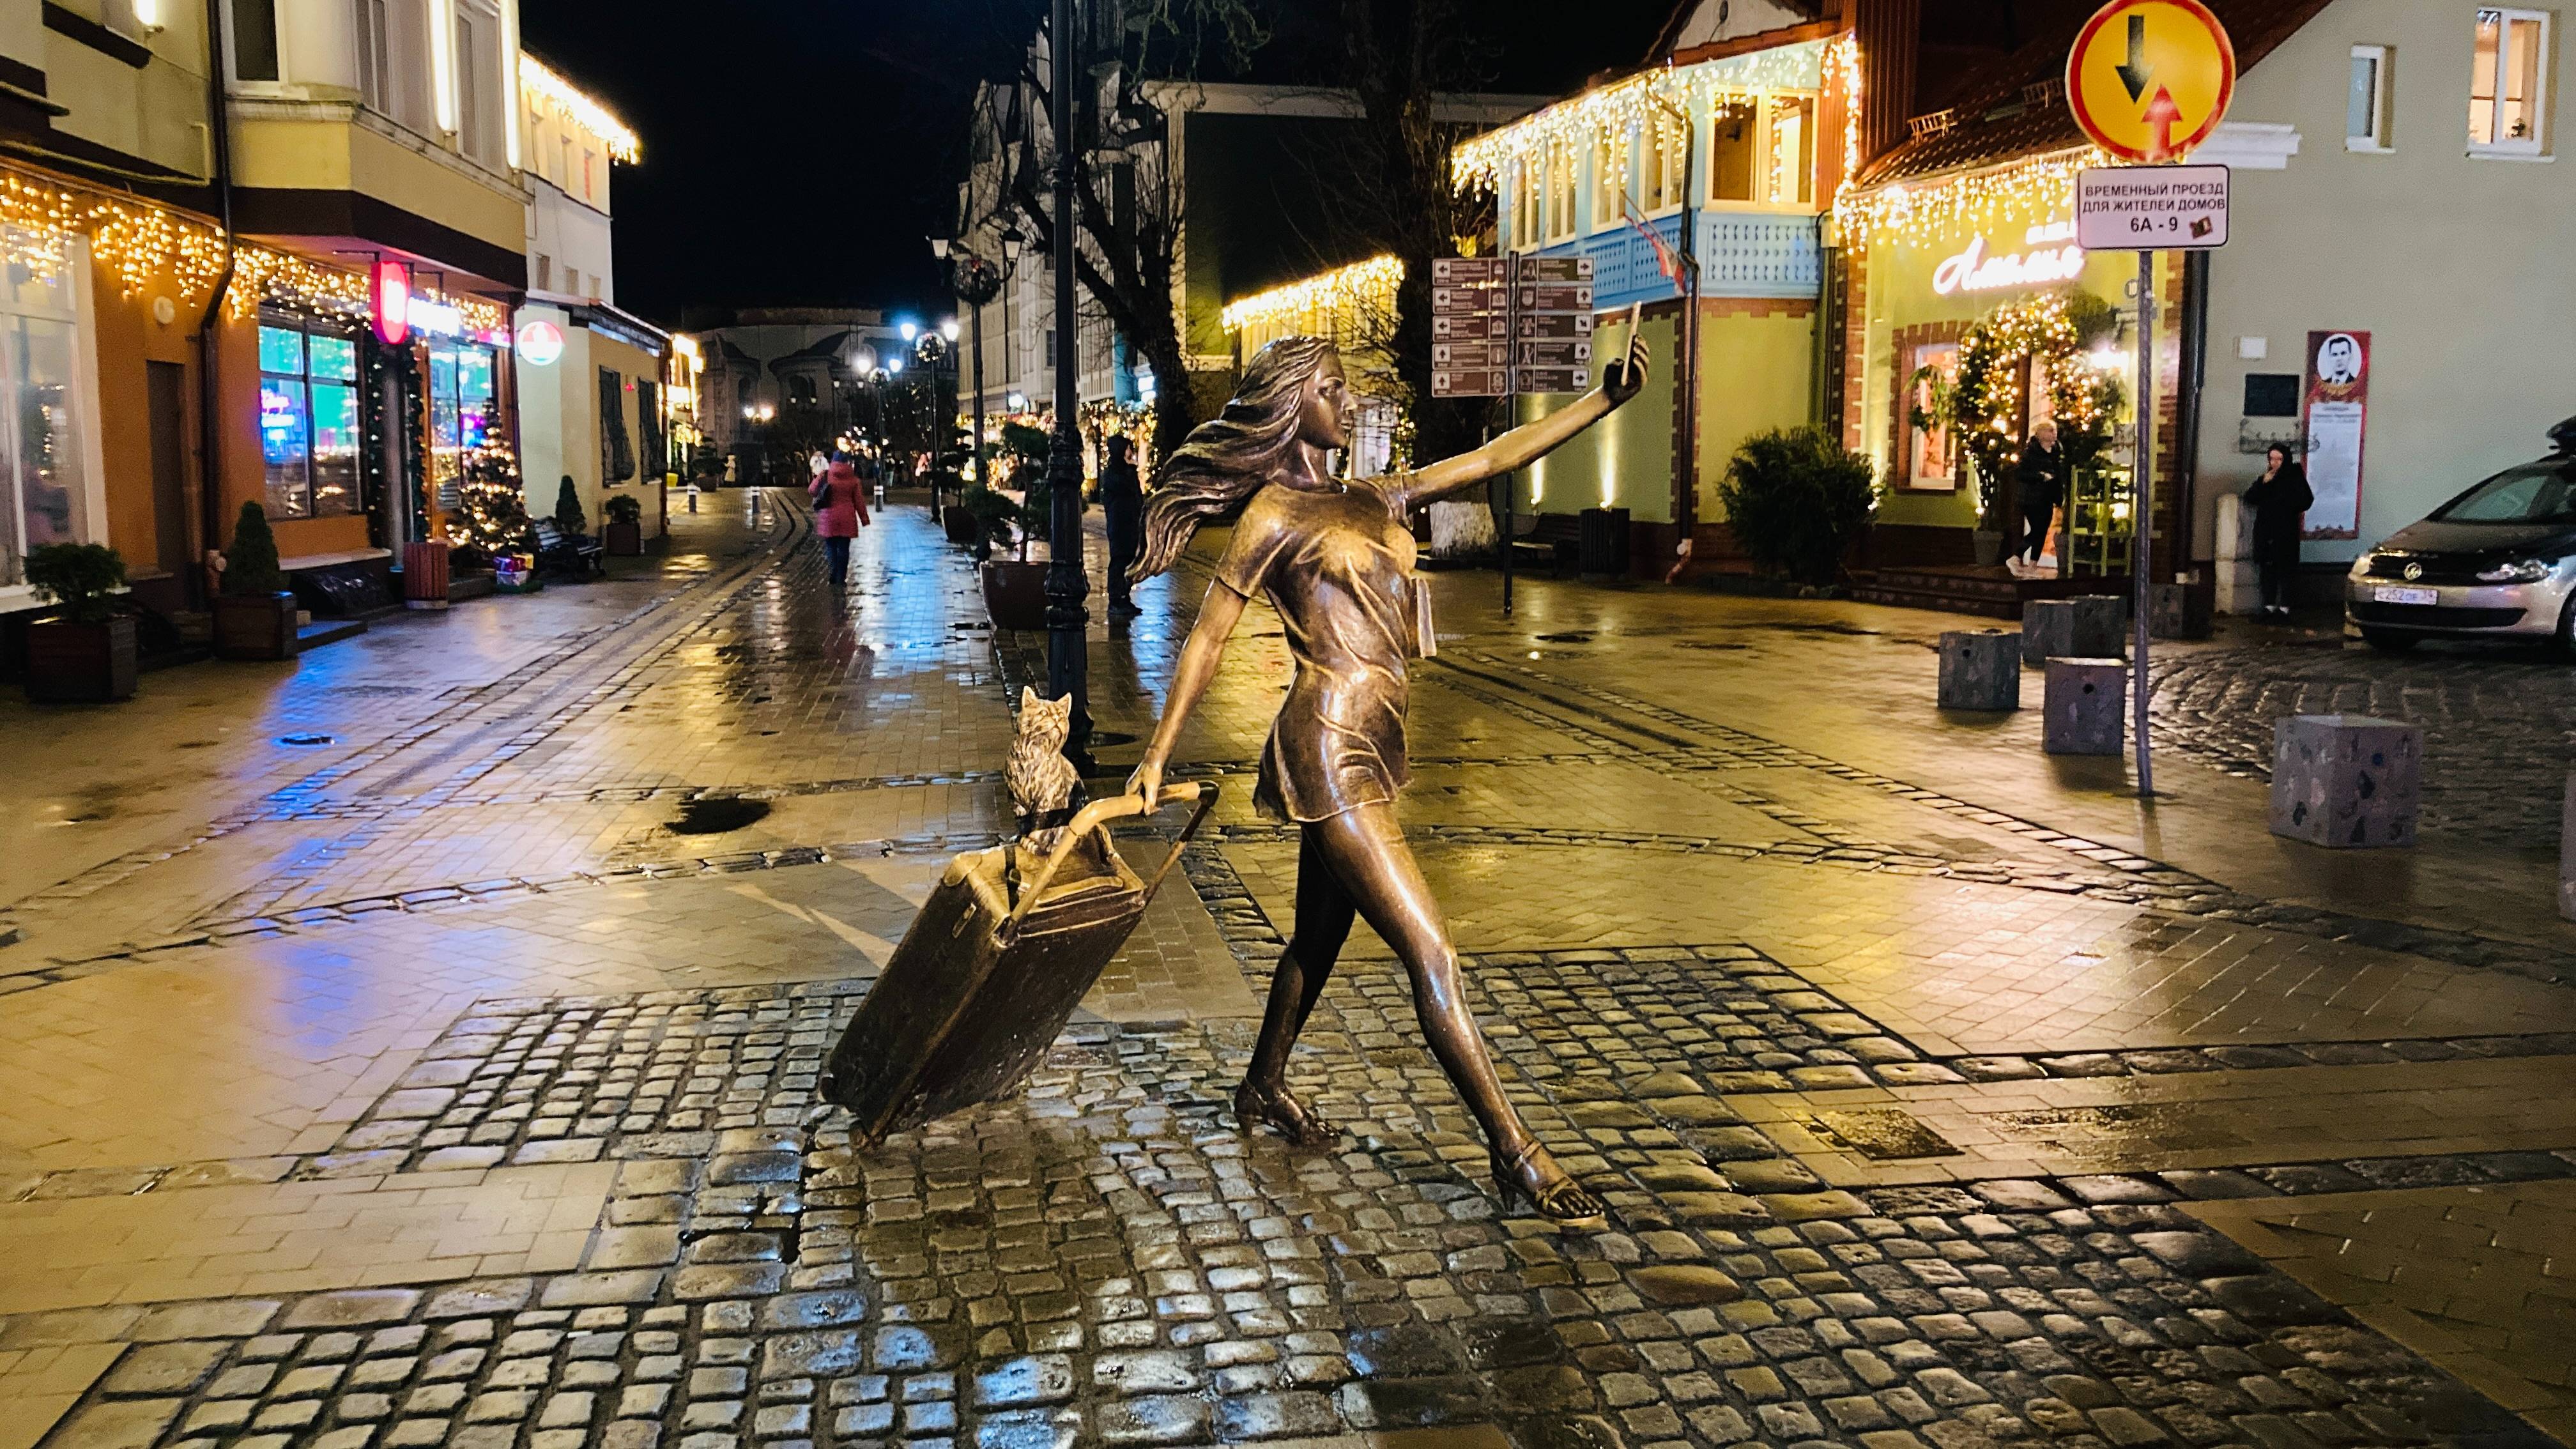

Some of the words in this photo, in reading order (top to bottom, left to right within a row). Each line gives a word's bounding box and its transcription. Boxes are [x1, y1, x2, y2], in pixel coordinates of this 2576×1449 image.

[2085, 183, 2168, 197] ВРЕМЕННЫЙ
[2172, 182, 2225, 196] ПРОЕЗД
[2083, 201, 2110, 213] ДЛЯ
[2113, 199, 2175, 212] ЖИТЕЛЕЙ
[2177, 199, 2225, 212] ДОМОВ
[2130, 217, 2152, 232] 6А
[2168, 217, 2178, 231] 9
